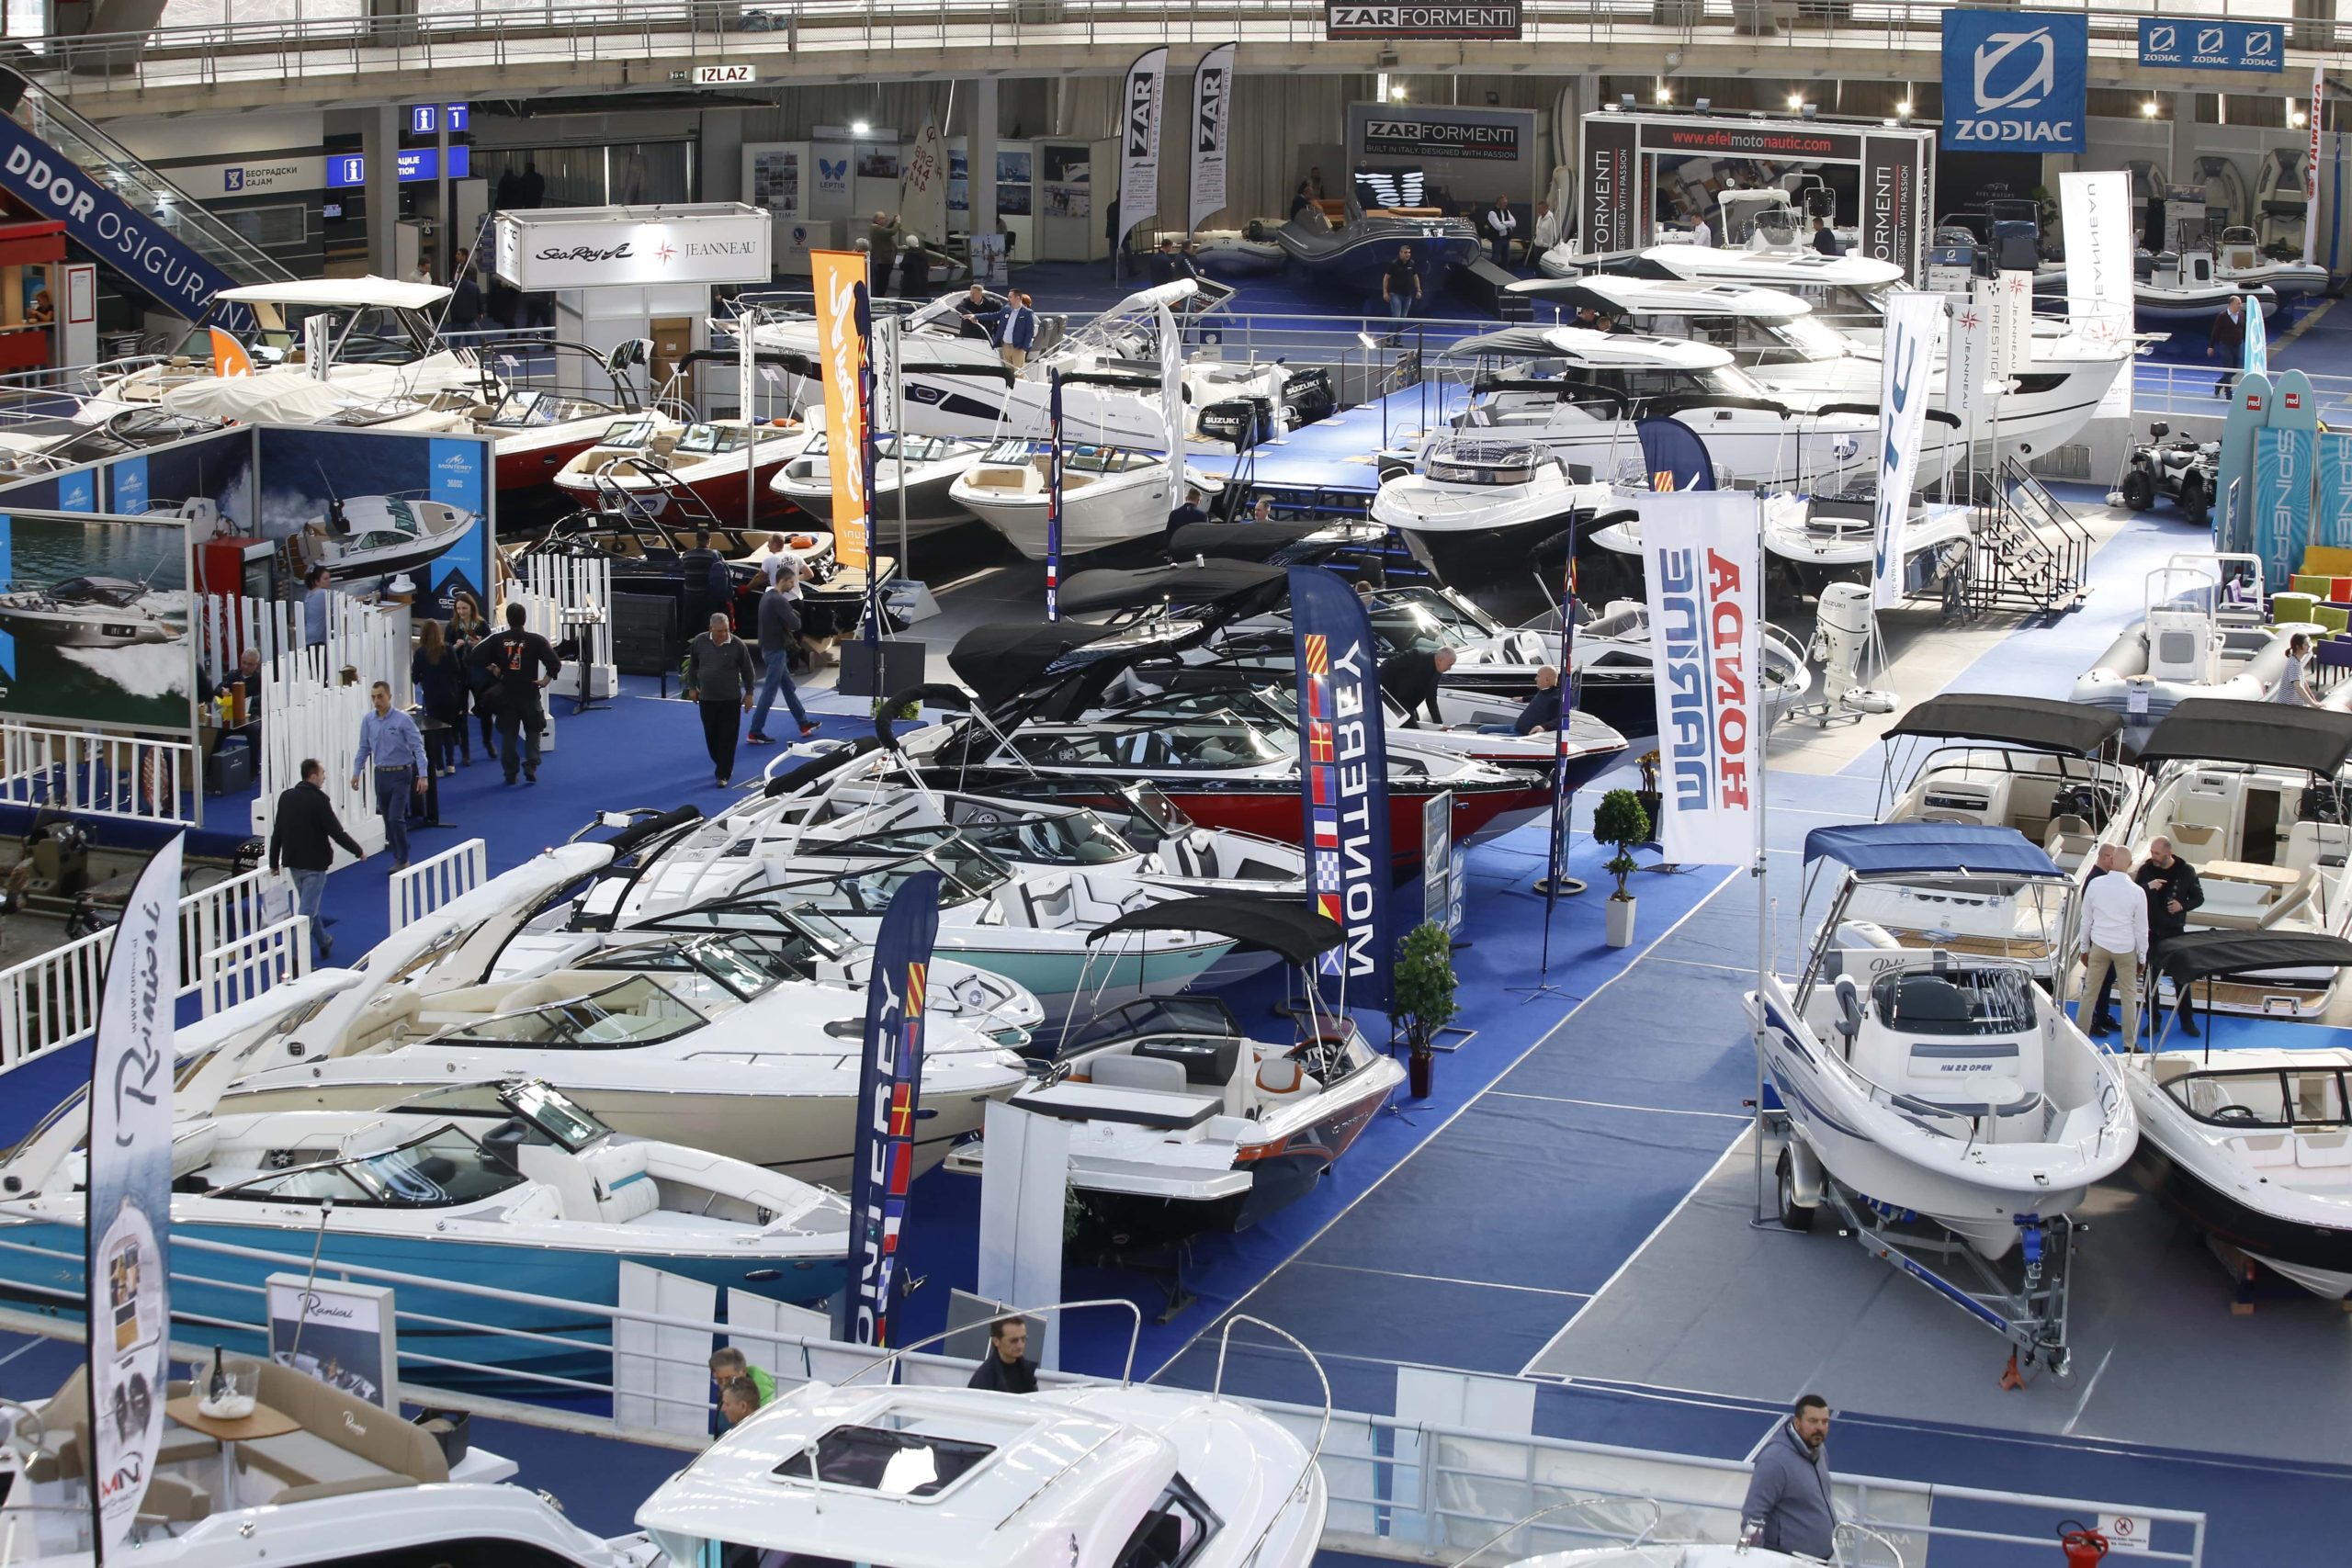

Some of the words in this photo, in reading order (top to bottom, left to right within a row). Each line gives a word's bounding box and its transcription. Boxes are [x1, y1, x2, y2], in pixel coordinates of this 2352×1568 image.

[1335, 9, 1396, 25] ZAR
[1400, 9, 1511, 26] FORMENTI
[2143, 53, 2181, 62] ZODIAC
[2192, 55, 2230, 64] ZODIAC
[2239, 58, 2278, 67] ZODIAC
[701, 67, 748, 82] IZLAZ
[1130, 79, 1153, 150] ZAR
[1201, 74, 1221, 144] ZAR
[453, 111, 459, 128] 1
[1370, 122, 1419, 137] ZAR
[1422, 124, 1514, 142] FORMENTI
[1954, 119, 2073, 141] ZODIAC
[1672, 131, 1831, 152] www.efelmotonautic.com
[1366, 144, 1387, 152] BUILT
[1421, 147, 1460, 156] DESIGNED
[1461, 149, 1481, 157] WITH
[1483, 151, 1516, 159] PASSION
[245, 166, 298, 178] БЕОГРАДСКИ
[6, 144, 96, 223] DDOR
[245, 178, 273, 187] САЈАМ
[820, 181, 845, 189] LEPTIR
[1900, 164, 1908, 202] PASSION
[1874, 166, 1892, 261] ORMENTI
[1899, 205, 1907, 228] WITH
[684, 241, 756, 258] JEANNEAU
[1898, 230, 1907, 267] ESIGNED
[1990, 304, 2000, 379] PRESTIGE
[2010, 301, 2018, 369] JEANNEAU
[1962, 336, 1973, 410] JEANNEAU
[1286, 378, 1320, 395] SUZUKI
[2248, 396, 2261, 407] red
[2286, 393, 2299, 405] red
[2336, 436, 2352, 548] SPINE
[2273, 429, 2295, 586] SPINERA
[1823, 599, 1846, 608] SUZUKI
[1969, 1064, 1993, 1072] OPEN
[855, 967, 899, 1346] ONTEREY
